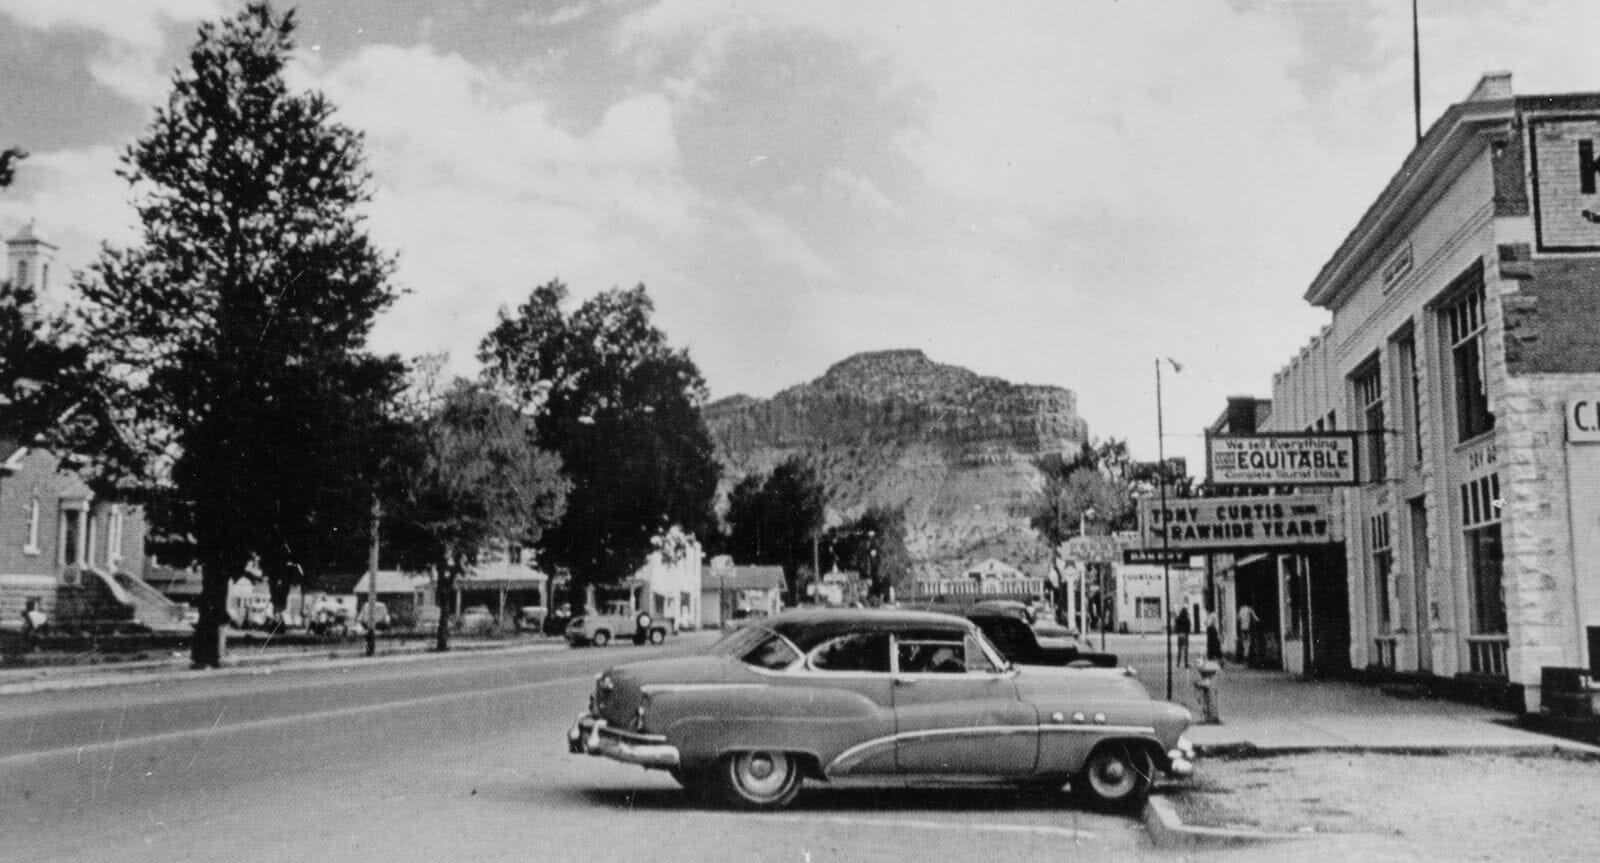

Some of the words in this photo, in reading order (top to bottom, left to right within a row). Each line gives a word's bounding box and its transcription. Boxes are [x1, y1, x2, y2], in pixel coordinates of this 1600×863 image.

[1270, 438, 1338, 451] Everything
[1237, 450, 1349, 470] EQUITABLE
[1151, 507, 1198, 524] TONY
[1216, 503, 1284, 522] CURTIS
[1171, 521, 1254, 541] RAWHIDE
[1262, 518, 1327, 539] YEARS
